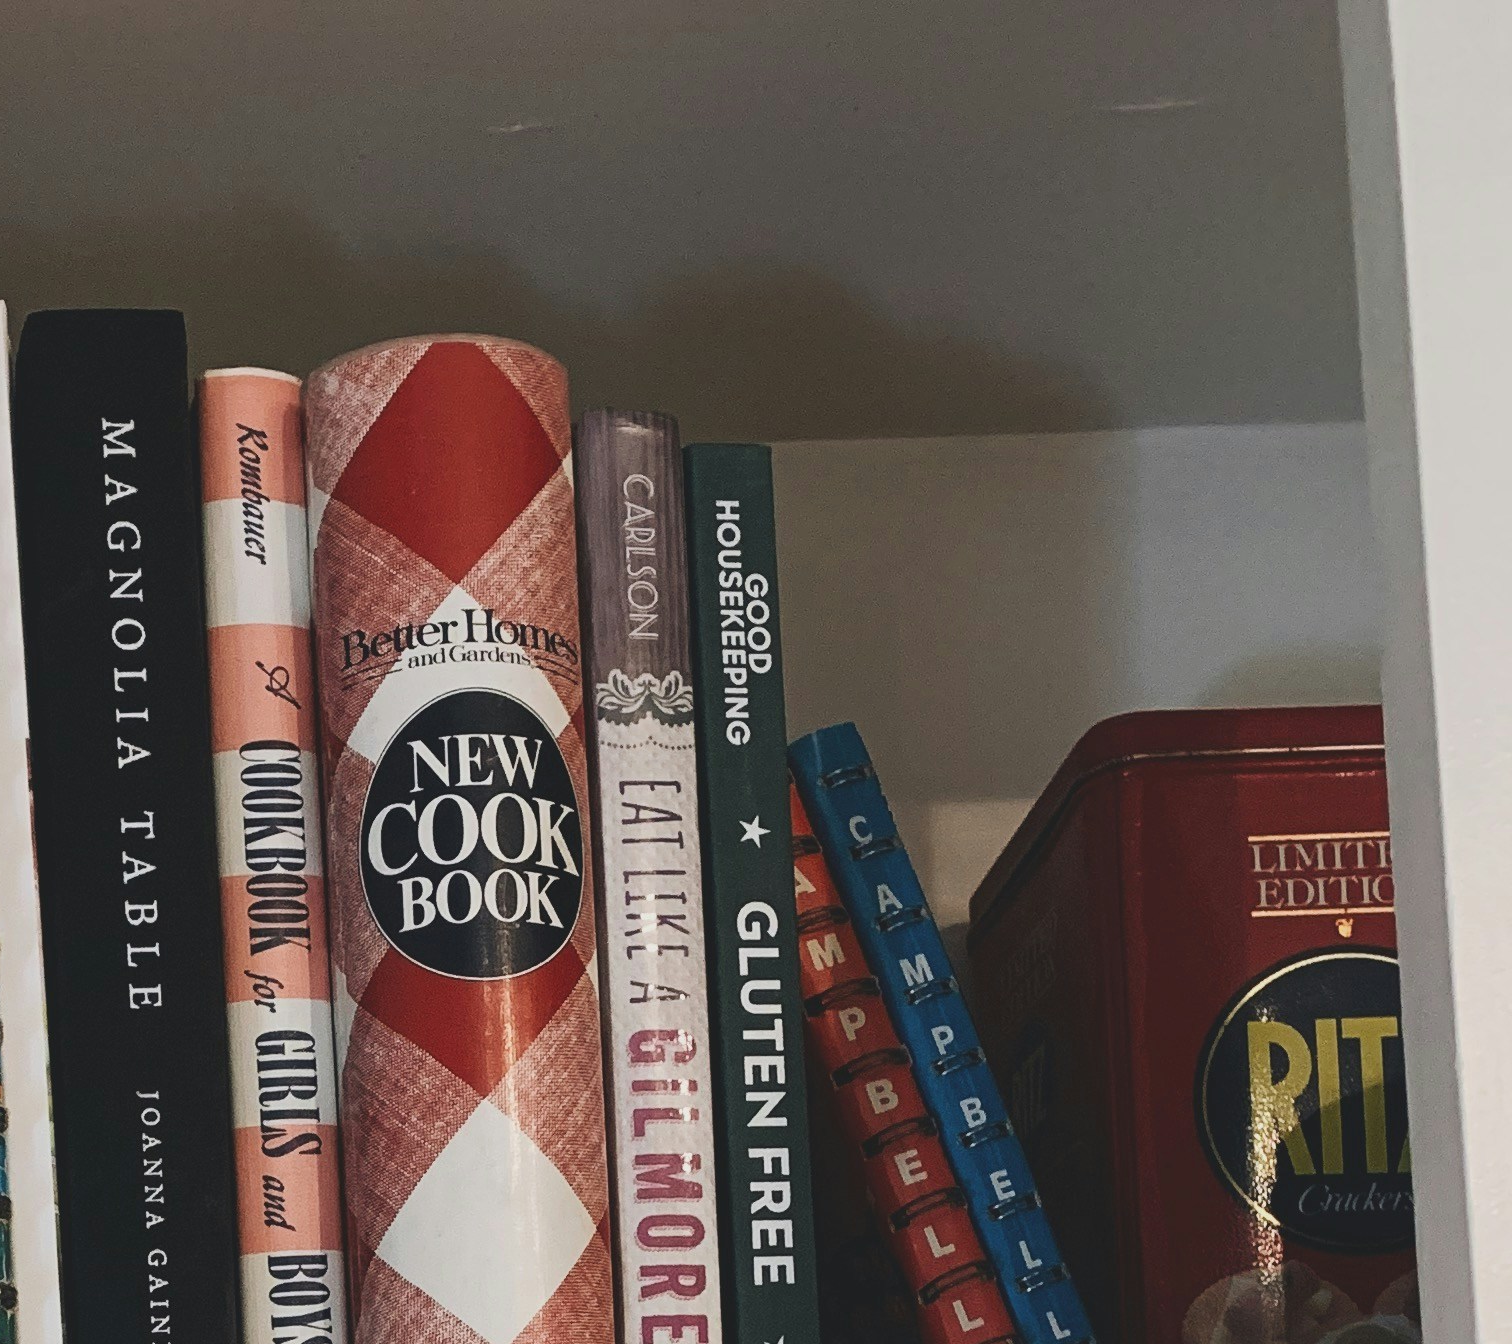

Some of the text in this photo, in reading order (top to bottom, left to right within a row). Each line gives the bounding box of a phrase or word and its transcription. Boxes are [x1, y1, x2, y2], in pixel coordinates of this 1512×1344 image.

[235, 422, 270, 566] Rombauer
[100, 417, 152, 770] MAGNOLIA
[622, 472, 660, 642] CARLSON
[340, 607, 579, 671] Better Homes
[407, 645, 532, 669] and Gardens
[714, 499, 753, 747] HOUSEKEEPING
[744, 573, 773, 675] GOOD
[406, 732, 543, 794] NEW
[237, 738, 312, 959] COOKBOOK
[366, 792, 580, 878] COOK
[617, 779, 685, 850] EAT
[120, 810, 164, 1010] TABLE
[396, 868, 565, 934] BOOK
[624, 868, 691, 962] LIKE
[1257, 873, 1395, 910] EDITIO
[245, 968, 285, 1014] for
[629, 979, 692, 1005] A
[255, 1029, 323, 1160] GIRLS
[735, 900, 797, 1287] GLUTEN FREE
[848, 814, 1072, 1341] CAMPBELL
[1245, 1016, 1412, 1178] RIT
[135, 1091, 167, 1230] JOANNA
[261, 1173, 297, 1233] and
